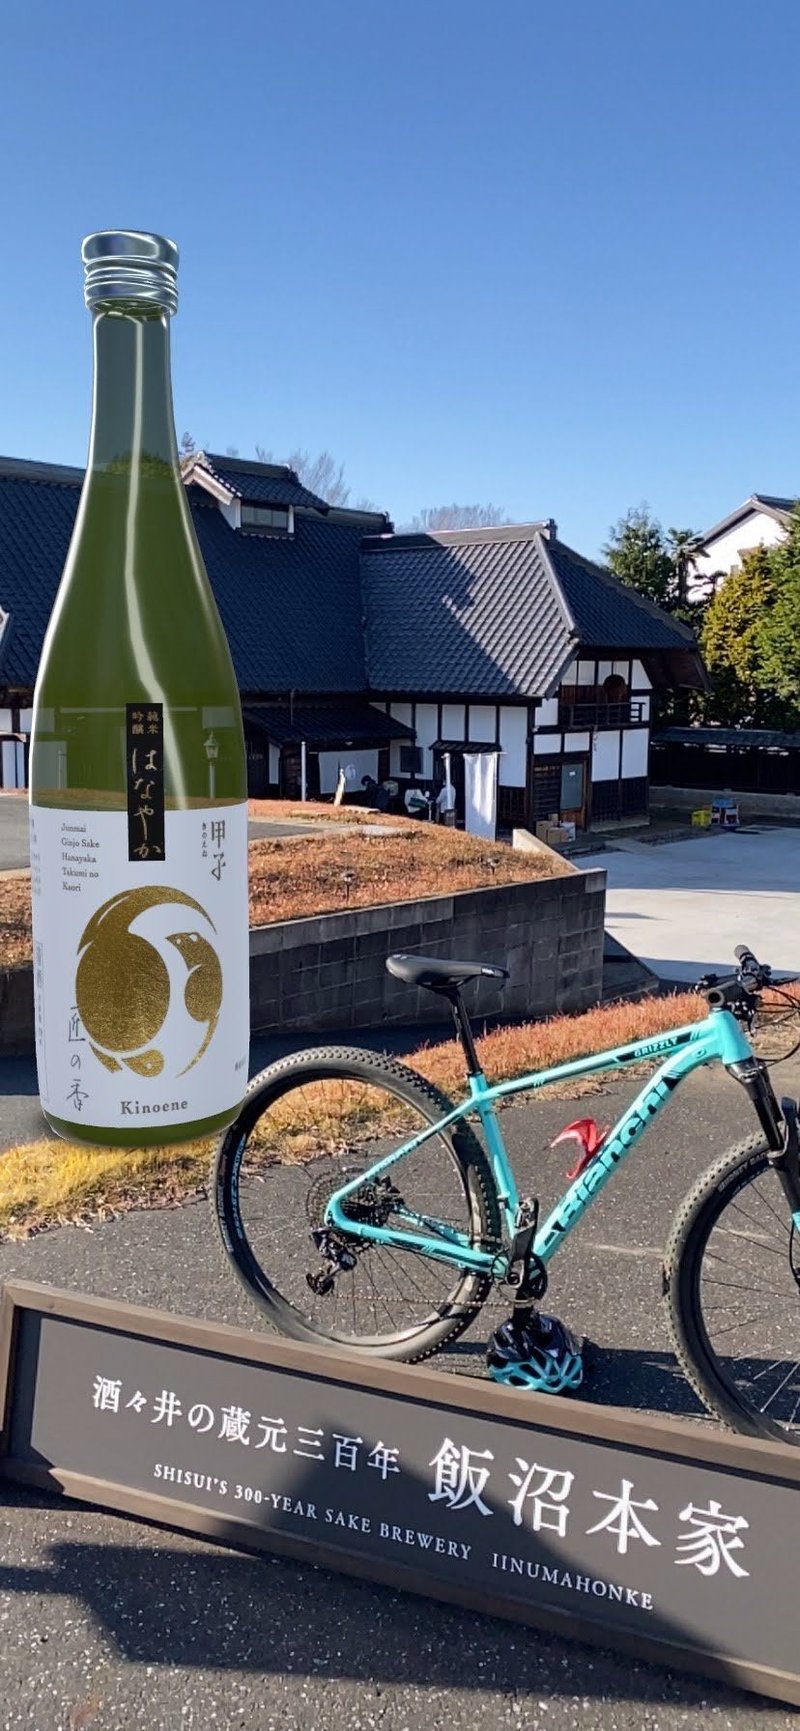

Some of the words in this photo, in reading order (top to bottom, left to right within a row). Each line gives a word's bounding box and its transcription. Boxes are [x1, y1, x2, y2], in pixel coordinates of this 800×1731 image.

[81, 839, 100, 849] Sake
[132, 747, 162, 860] はなやか
[211, 819, 226, 881] 甲子
[634, 1036, 678, 1058] GRIZZLY
[120, 1100, 188, 1115] Kinoene
[557, 1077, 672, 1227] Bianchi
[92, 1374, 401, 1481] 酒々井の蔵元三百年
[428, 1437, 750, 1578] 飯沼本家
[234, 1484, 318, 1520] 300-YEAR
[325, 1507, 372, 1533] SAKE
[379, 1521, 473, 1561] BREWERY
[491, 1552, 654, 1611] IINUMAHONKE
